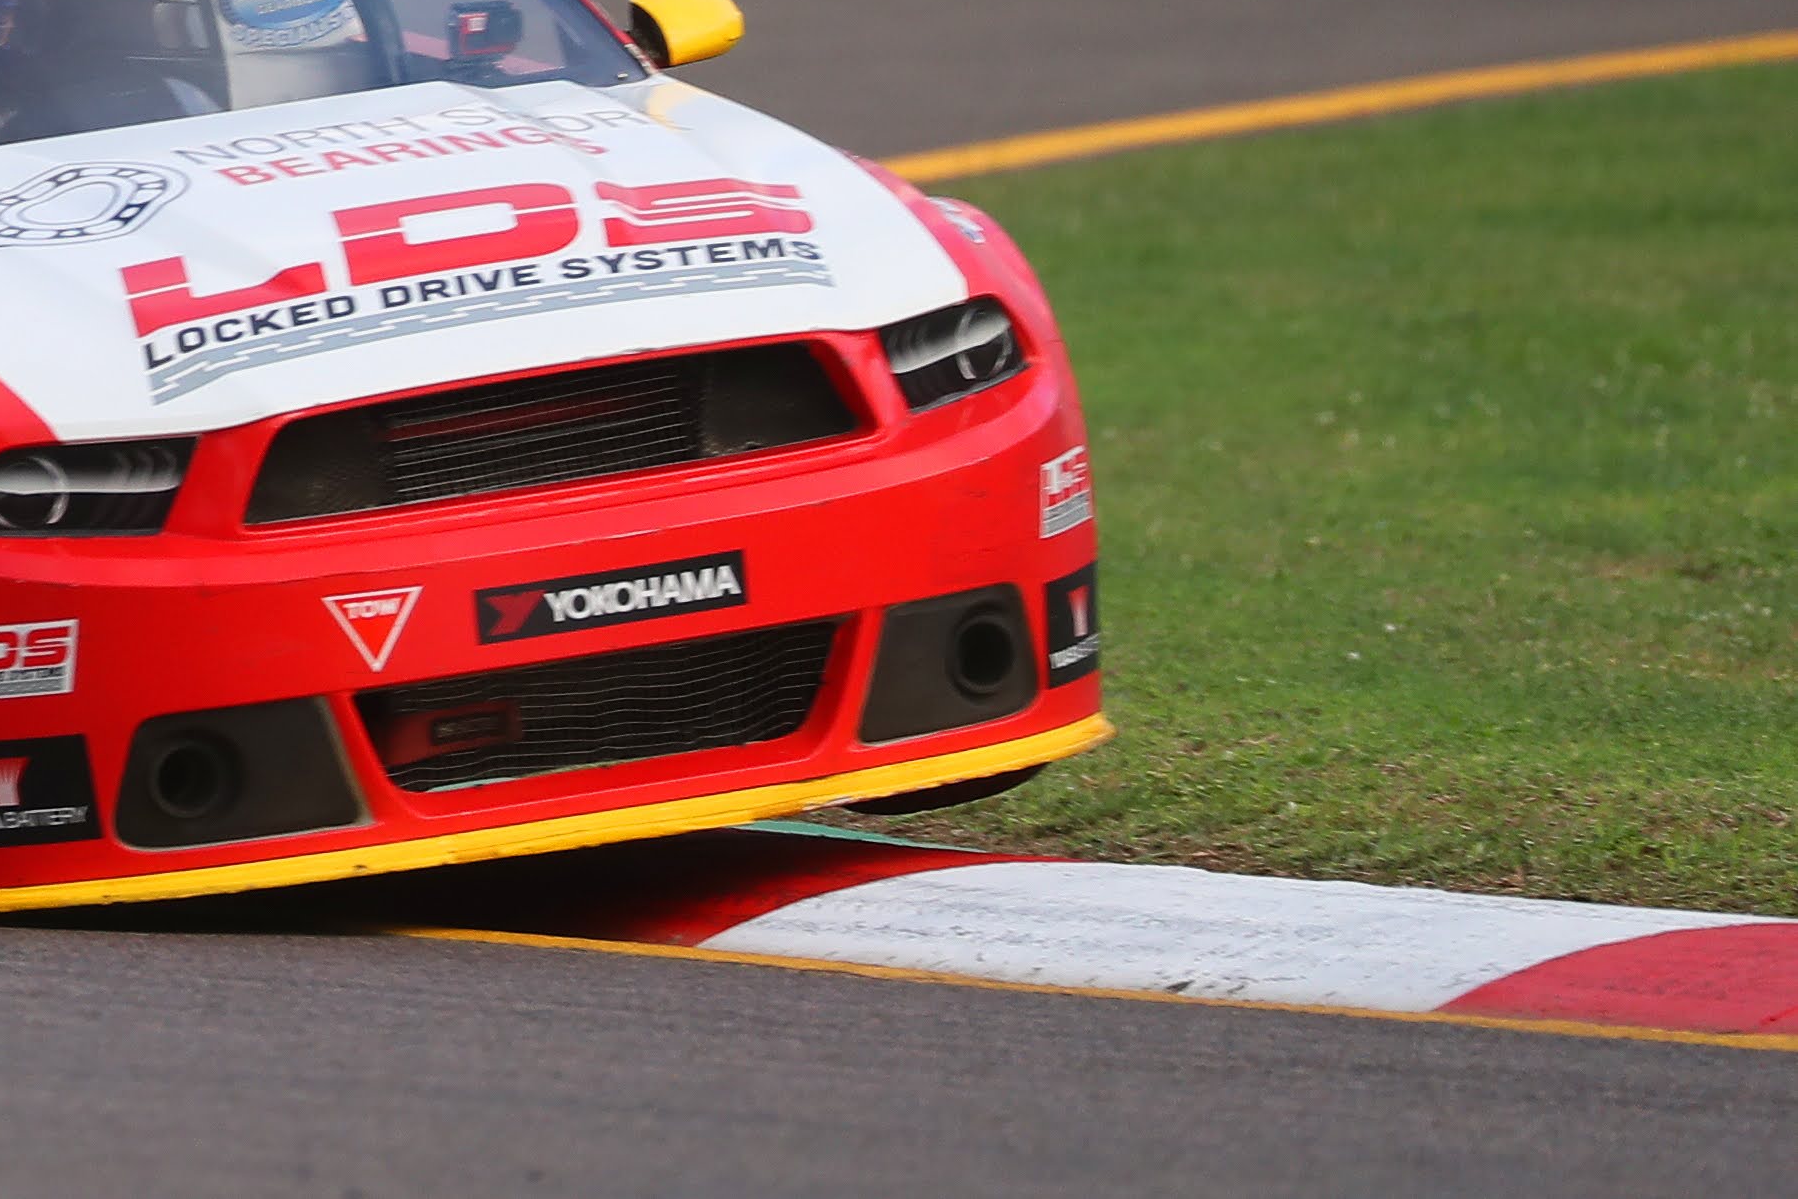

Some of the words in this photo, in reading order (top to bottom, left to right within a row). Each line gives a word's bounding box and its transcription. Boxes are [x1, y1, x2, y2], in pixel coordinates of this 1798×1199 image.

[171, 114, 428, 167] NORTH
[216, 125, 610, 187] BEARINGS
[116, 177, 816, 339] LDS
[143, 294, 356, 370] LOCKED
[378, 264, 543, 309] DRIVE
[561, 237, 826, 281] SYSTEMS
[544, 564, 742, 624] YOKOHAMA
